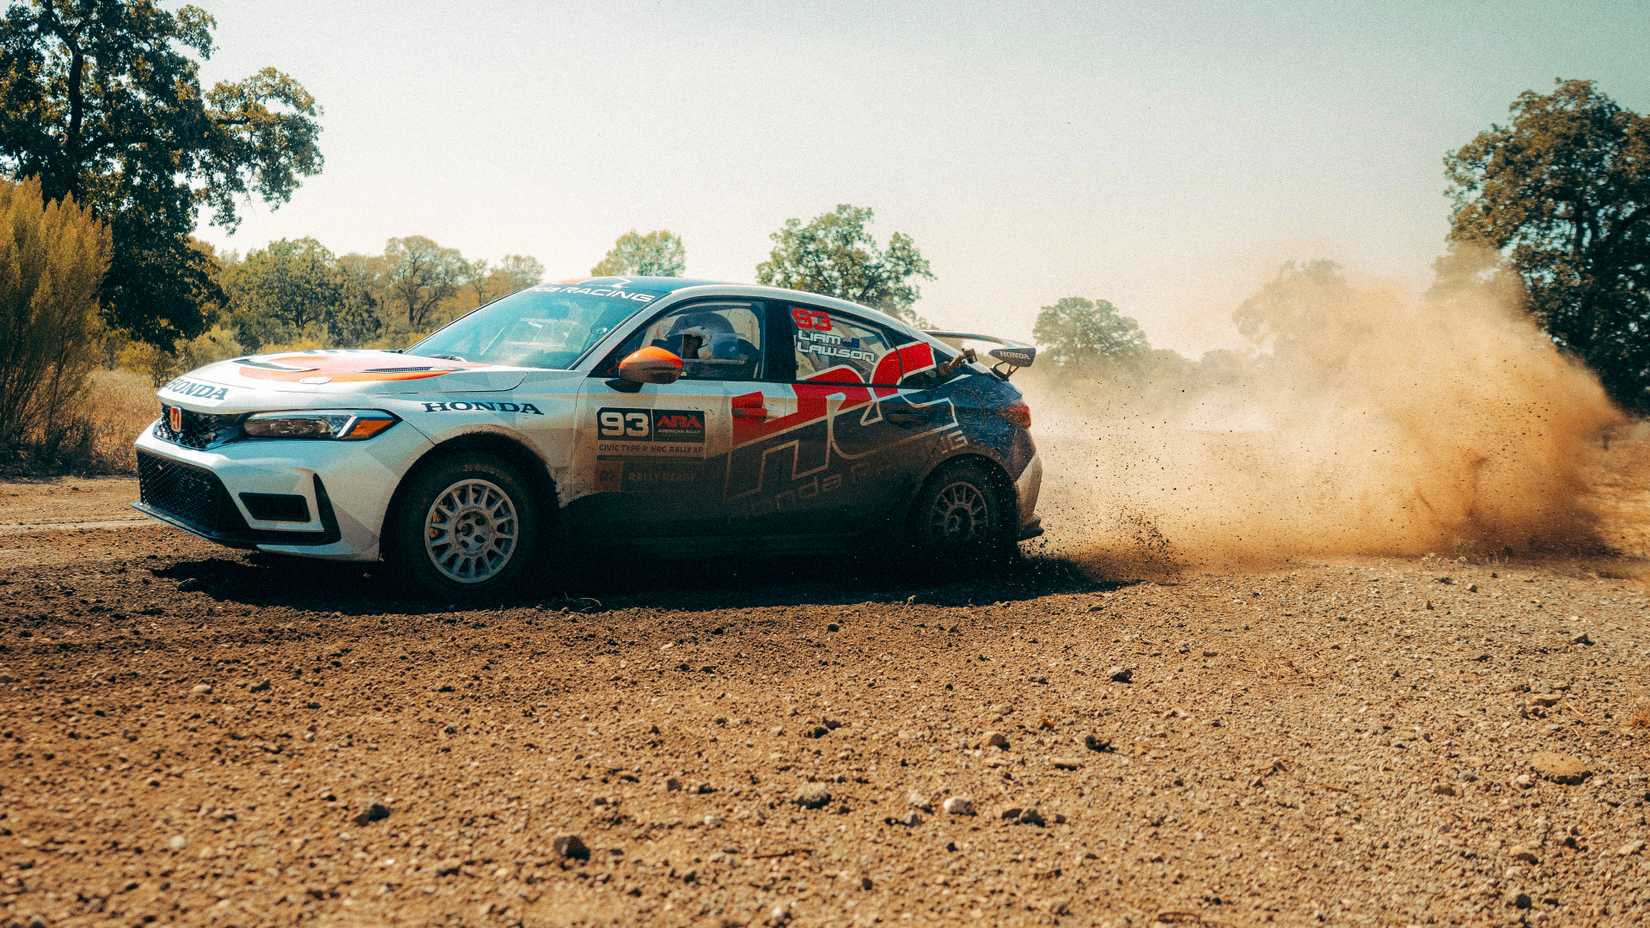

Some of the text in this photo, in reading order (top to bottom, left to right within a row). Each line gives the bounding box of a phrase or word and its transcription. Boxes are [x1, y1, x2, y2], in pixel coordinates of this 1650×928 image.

[560, 286, 656, 303] RACING
[796, 341, 876, 362] LAWSON
[1000, 350, 1031, 360] HONDA
[167, 378, 230, 401] HONDA
[421, 401, 545, 416] HONDA
[600, 411, 650, 437] 93
[656, 415, 704, 429] ARA
[599, 444, 619, 452] CIVIC
